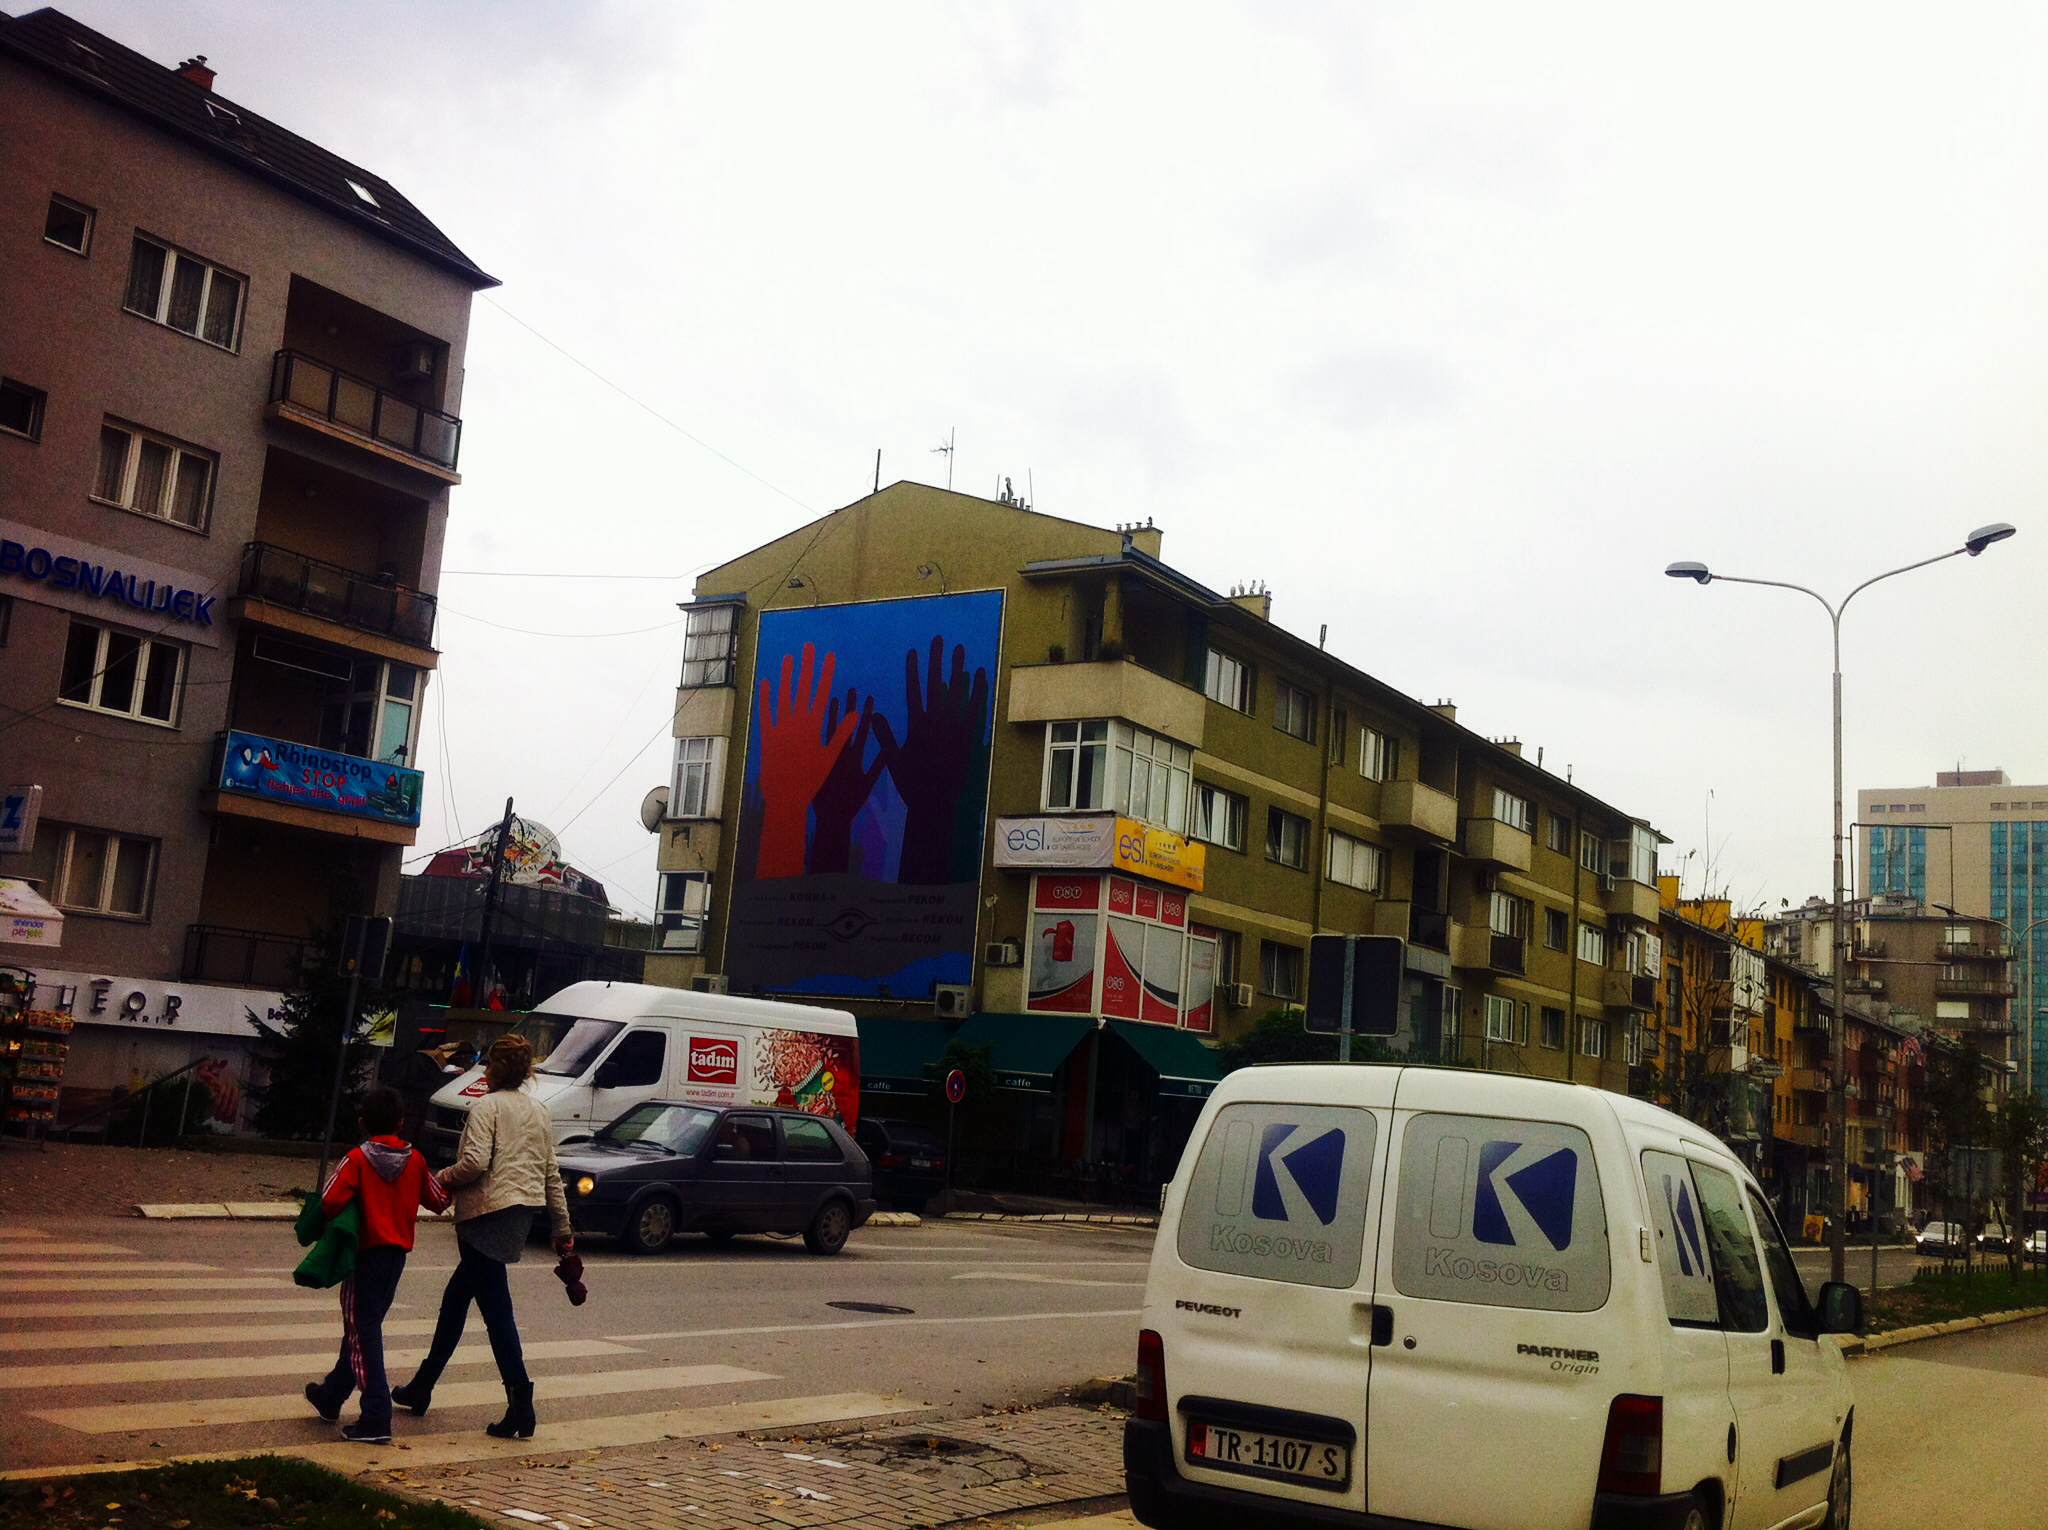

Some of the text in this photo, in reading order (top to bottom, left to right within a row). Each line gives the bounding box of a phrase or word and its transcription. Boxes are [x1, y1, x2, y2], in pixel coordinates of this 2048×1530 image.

[0, 539, 216, 625] BOSNALIJEK
[275, 743, 372, 782] Rhinostop
[302, 767, 347, 791] STOP
[1053, 886, 1083, 899] TNT
[119, 1011, 175, 1026] PARIS
[1004, 1077, 1032, 1088] caffe
[1209, 1224, 1332, 1264] Kosova
[1425, 1246, 1569, 1292] Kosova
[1175, 1299, 1243, 1319] PEUGEOT
[1516, 1343, 1600, 1363] PARTNER
[1550, 1360, 1600, 1376] Origin
